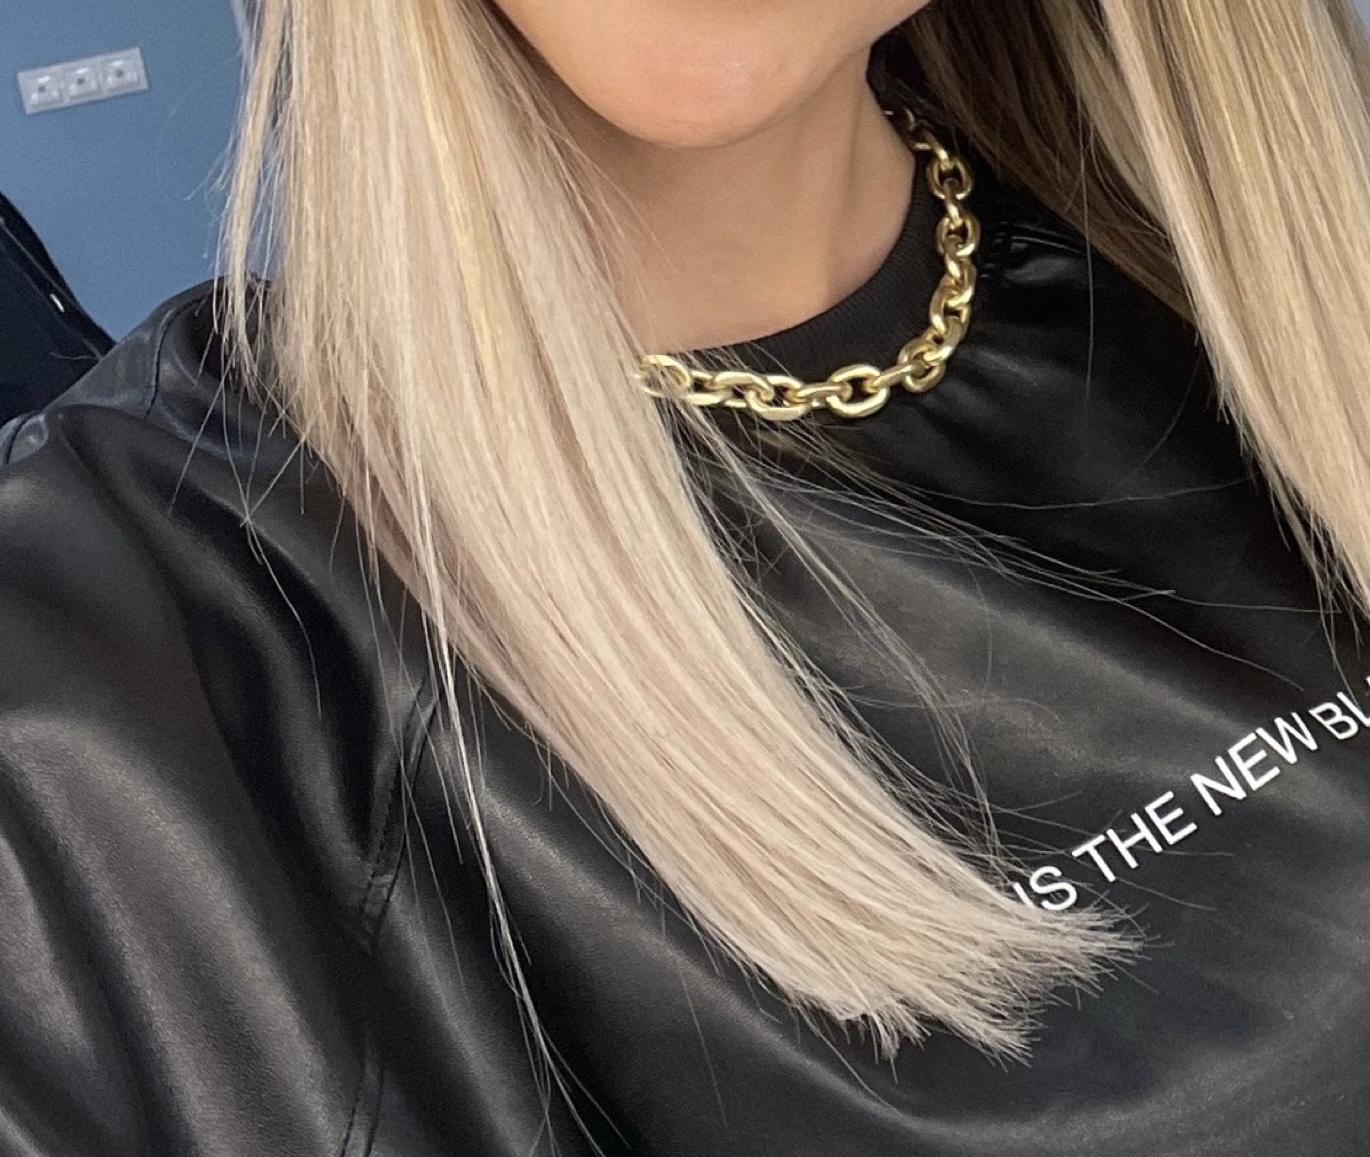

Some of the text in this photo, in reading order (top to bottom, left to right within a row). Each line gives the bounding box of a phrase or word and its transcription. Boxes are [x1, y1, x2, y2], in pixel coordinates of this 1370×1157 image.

[1012, 865, 1078, 912] IS
[1071, 790, 1198, 883] THE
[1190, 711, 1319, 817] NEW
